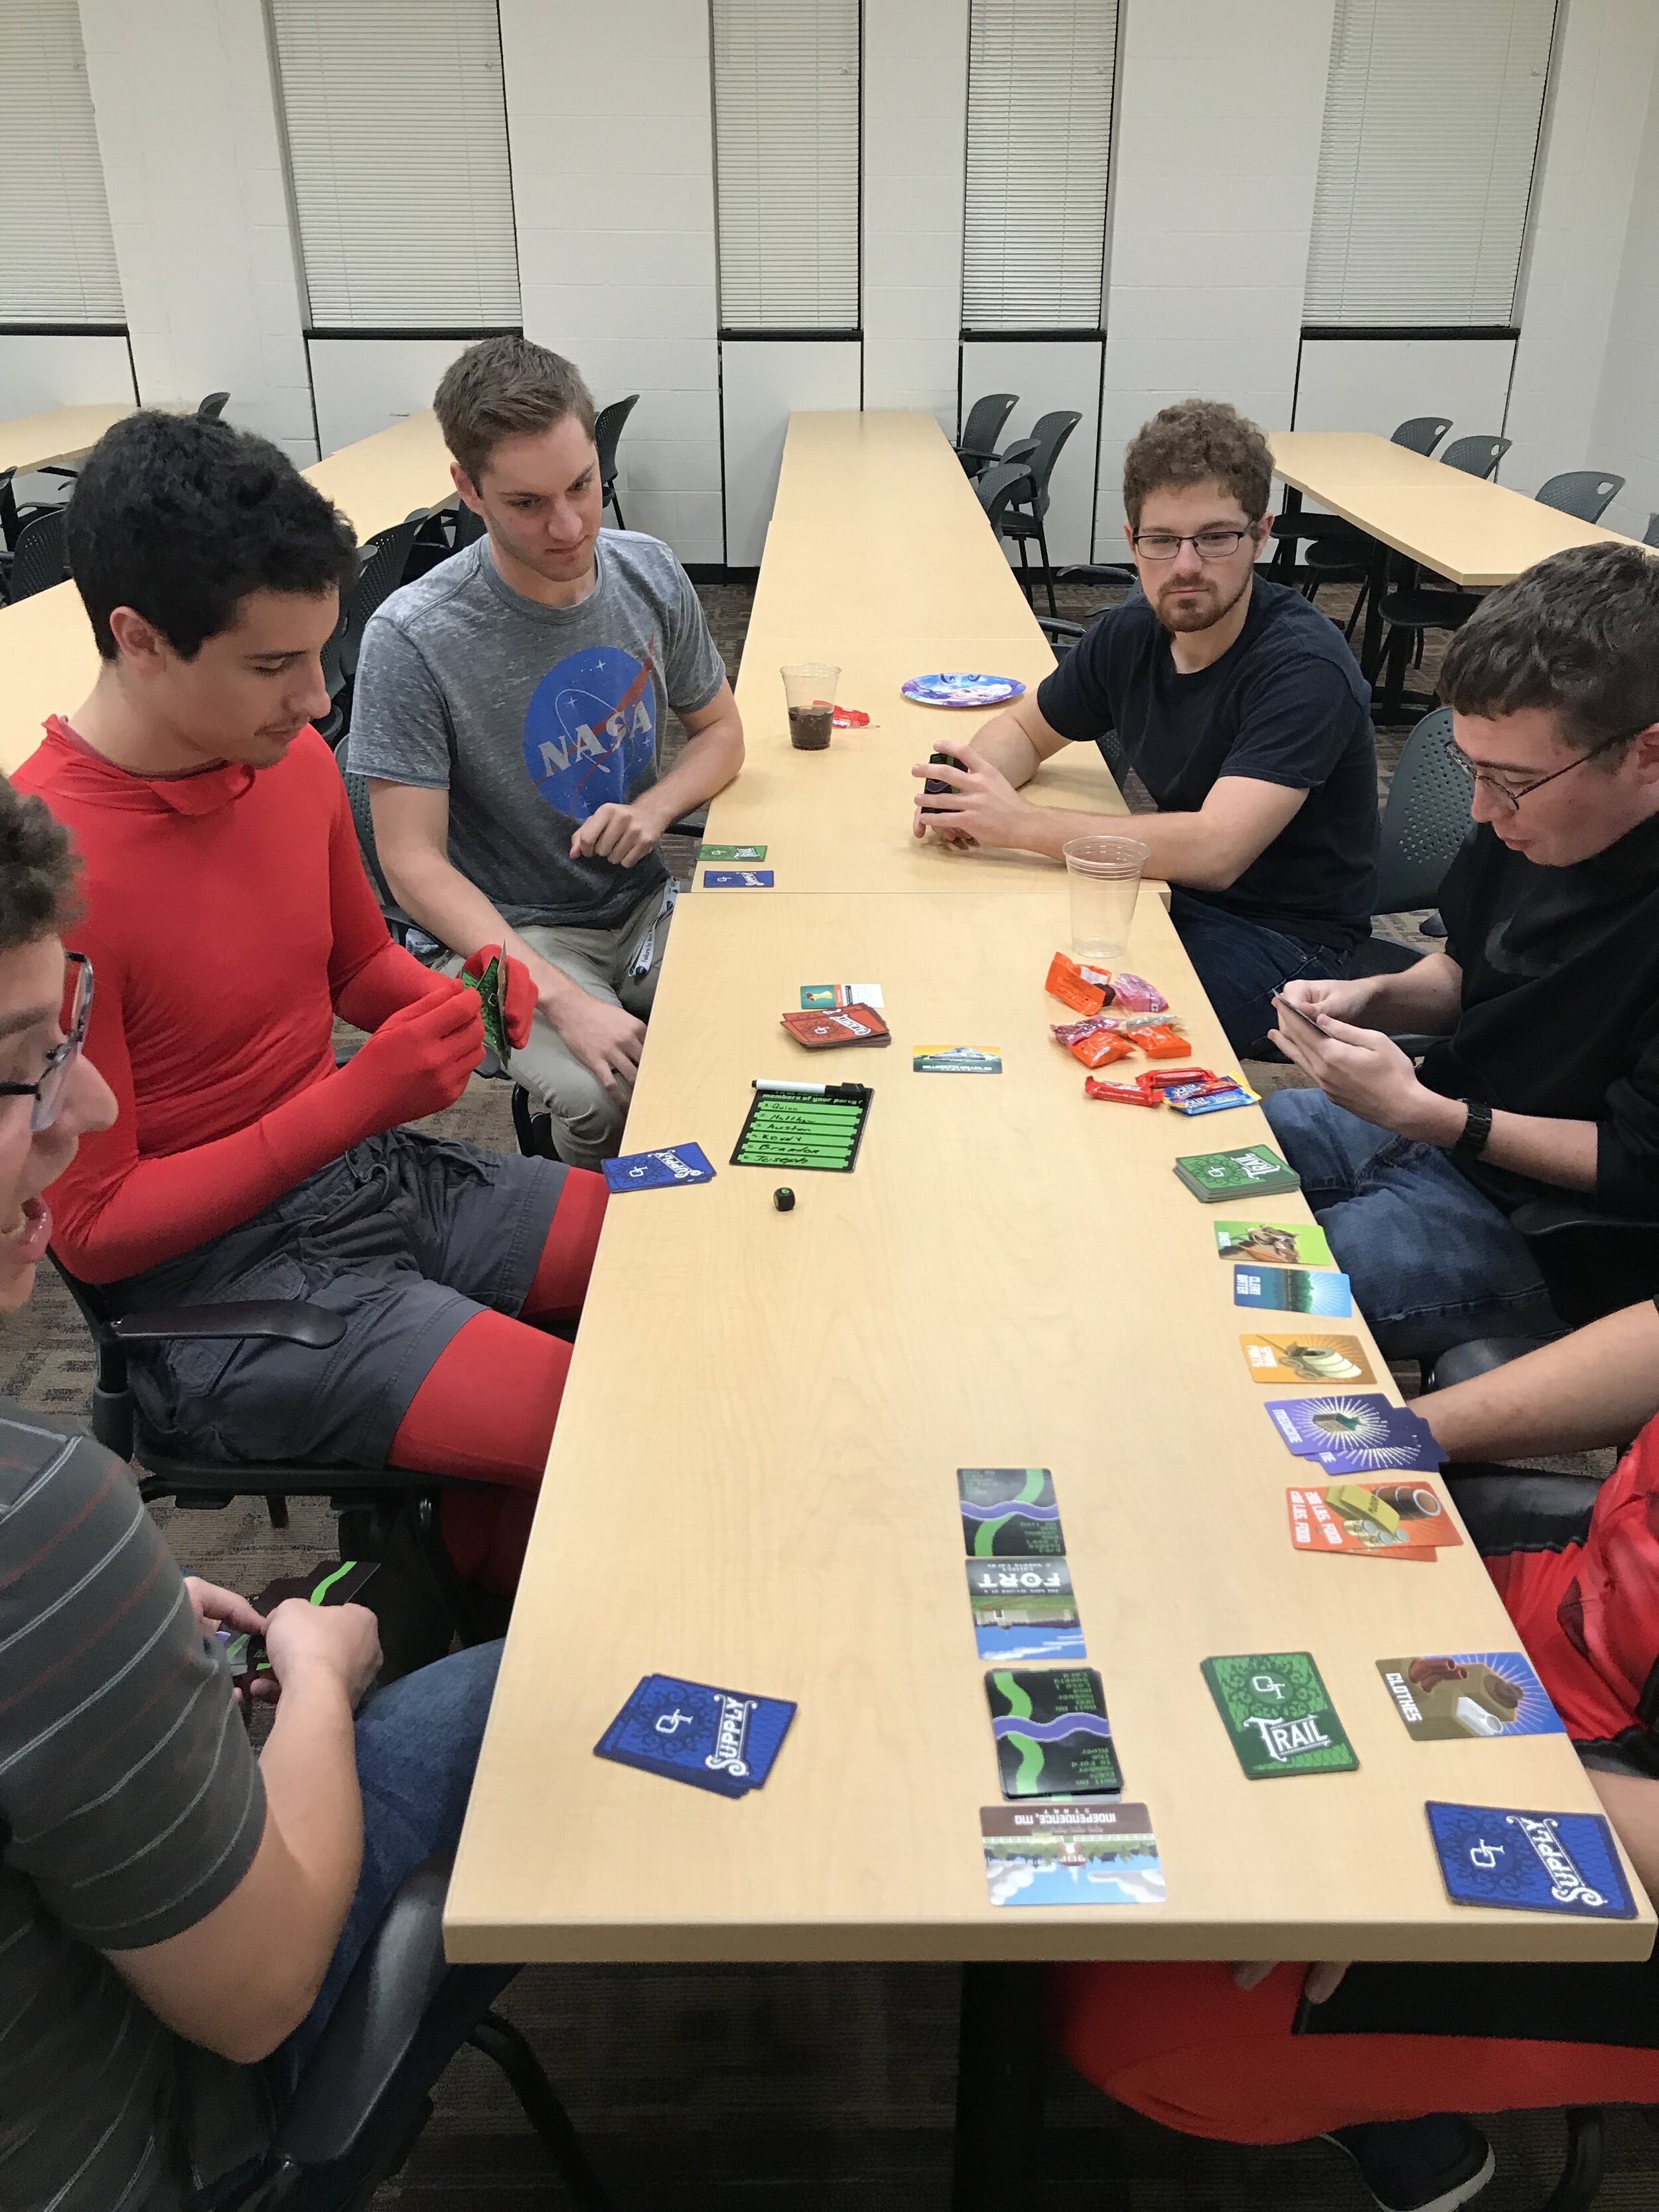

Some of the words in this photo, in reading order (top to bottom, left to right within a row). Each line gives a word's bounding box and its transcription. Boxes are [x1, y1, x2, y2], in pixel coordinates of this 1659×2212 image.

[538, 700, 652, 777] NASA
[649, 1149, 704, 1178] SUPPLY
[754, 1155, 808, 1164] Joseph
[1230, 1152, 1281, 1179] TRAIL
[977, 1572, 1061, 1587] FORT
[1386, 1672, 1423, 1722] CLOTHES
[705, 1694, 755, 1777] SUPPLY
[1243, 1714, 1333, 1763] TRAIL
[1510, 1815, 1607, 1906] SUPPLY
